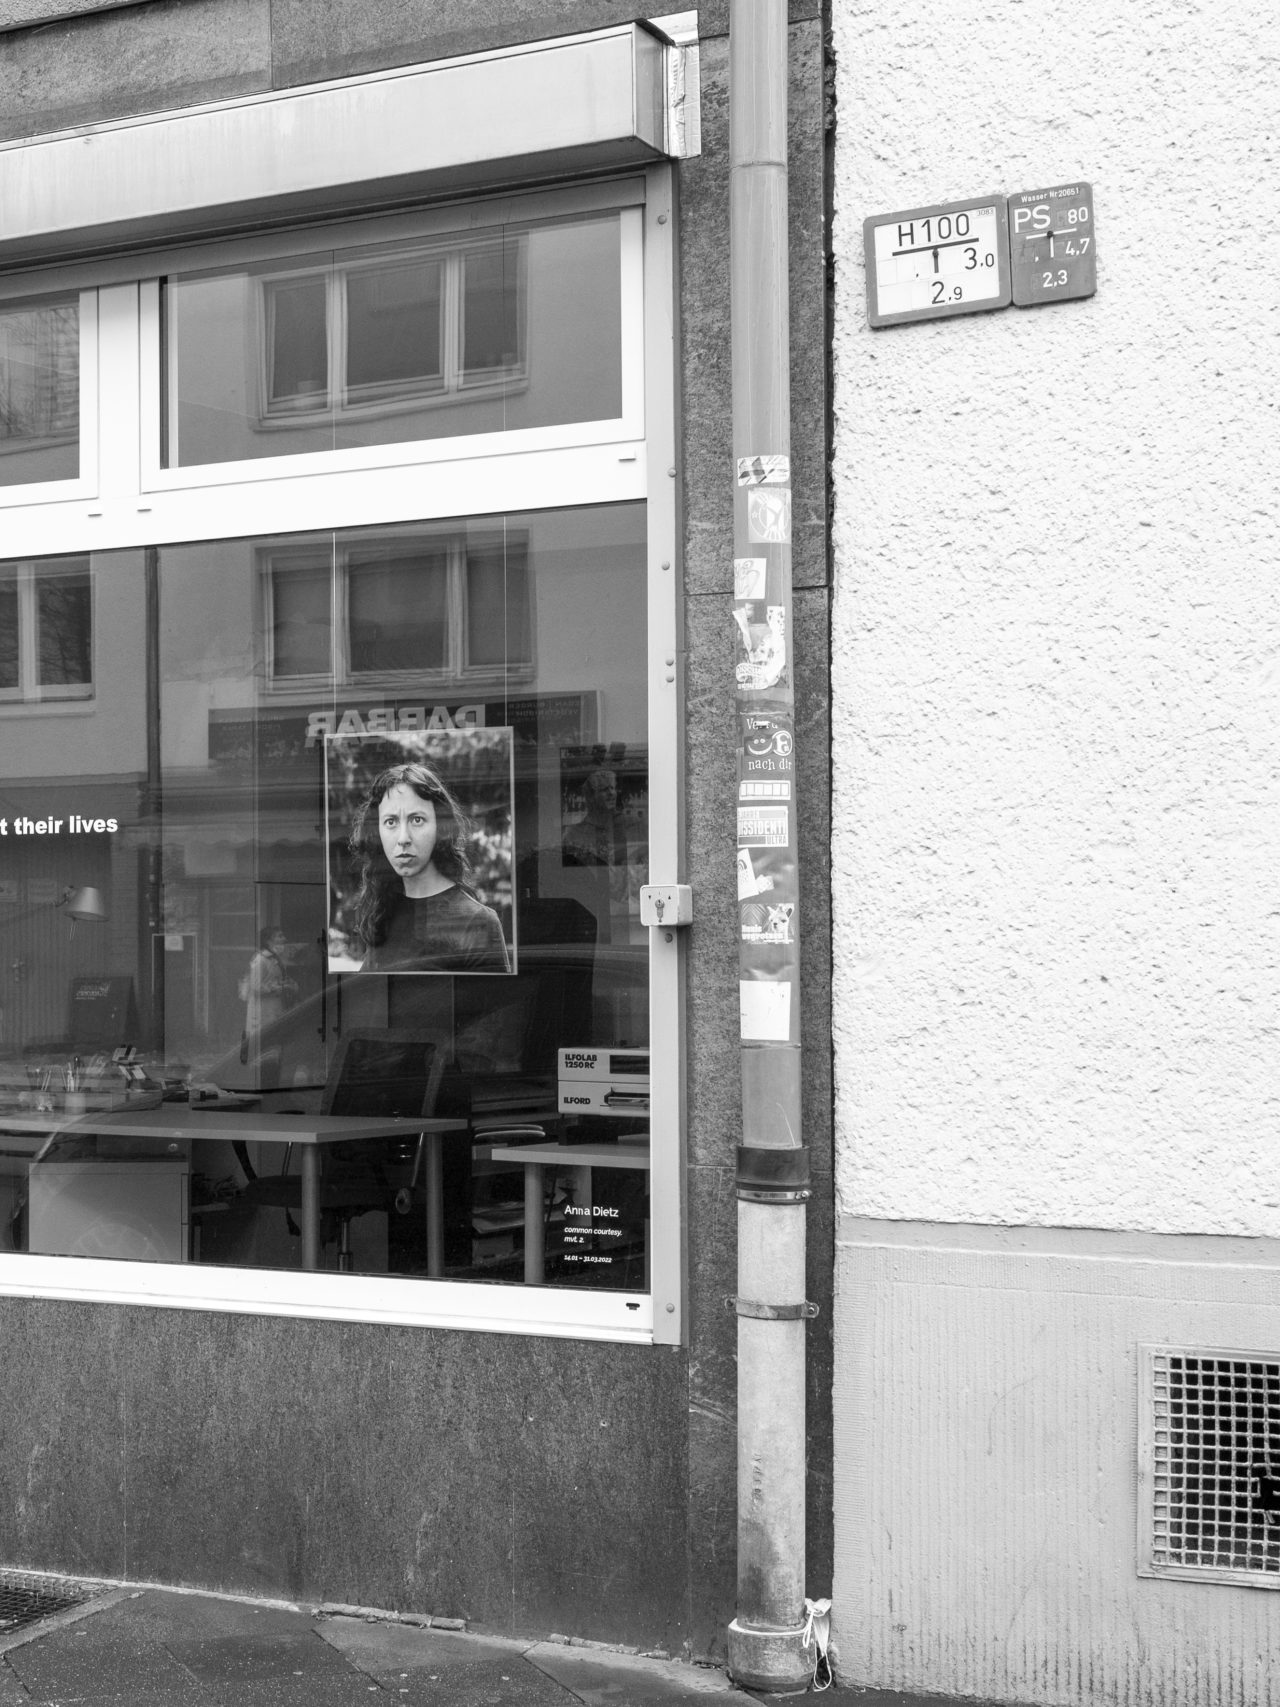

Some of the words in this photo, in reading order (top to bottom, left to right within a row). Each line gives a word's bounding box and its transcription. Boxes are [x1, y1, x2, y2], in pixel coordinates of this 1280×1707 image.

[1021, 193, 1047, 203] Wasser
[1014, 204, 1051, 234] PS
[1067, 206, 1089, 225] 80
[1042, 269, 1068, 288] 2,3
[748, 758, 776, 771] nach
[778, 757, 793, 770] dir
[14, 816, 63, 835] their
[69, 815, 118, 833] lives
[564, 1053, 598, 1062] ILFOLAB
[564, 1061, 584, 1069] 1250
[563, 1096, 591, 1105] ILFORD
[564, 1204, 591, 1216] Anna
[592, 1206, 619, 1218] Dietz
[564, 1226, 593, 1235] common
